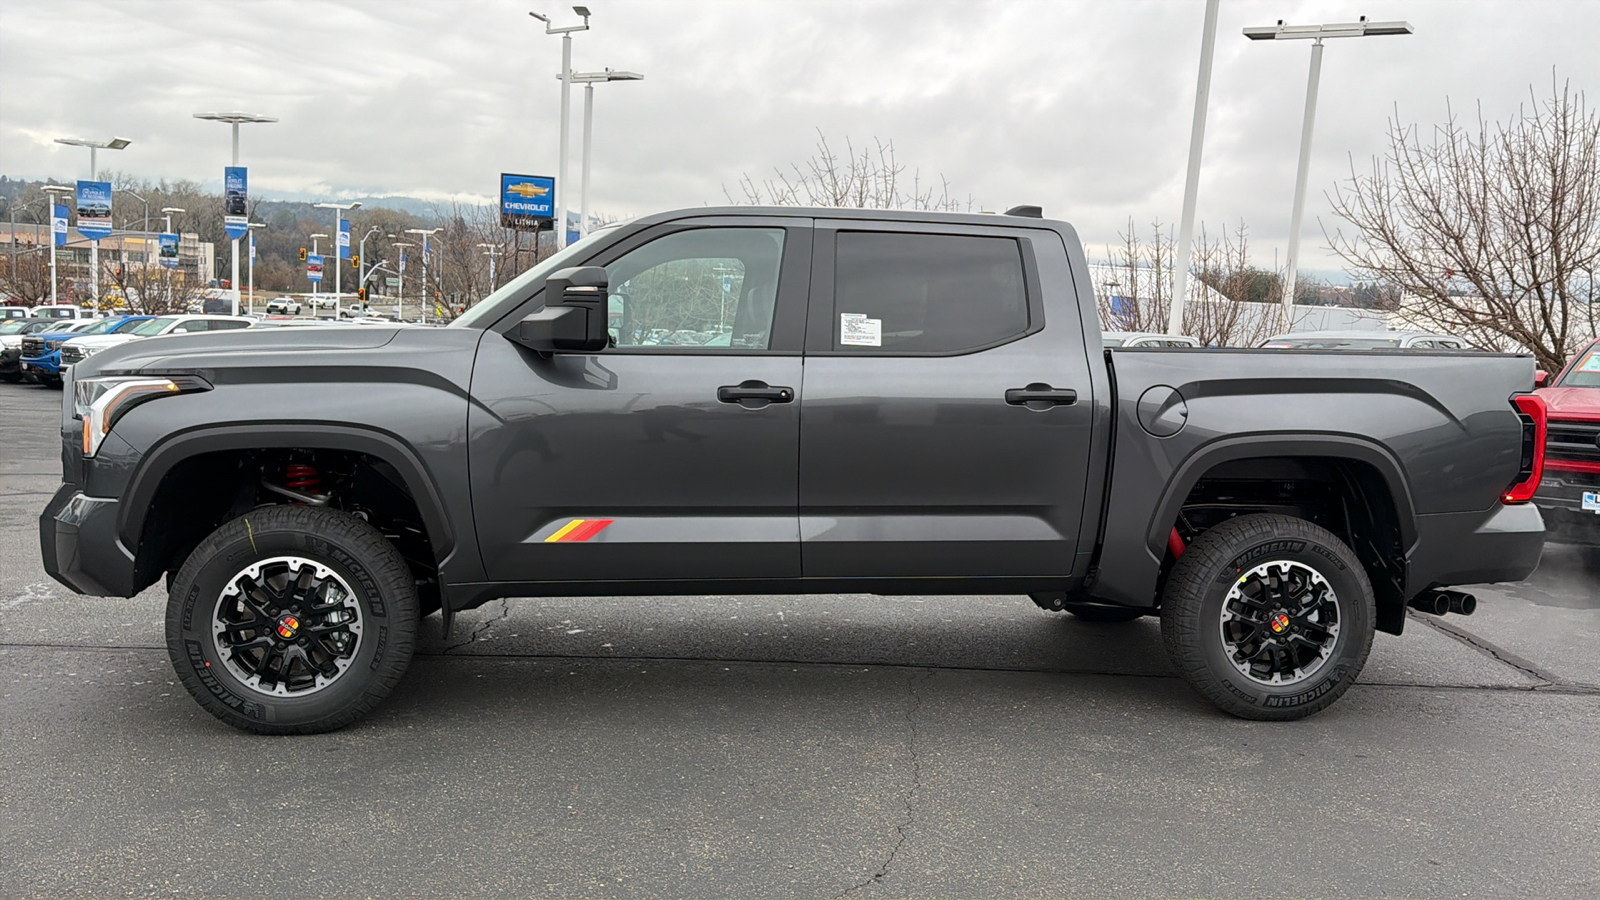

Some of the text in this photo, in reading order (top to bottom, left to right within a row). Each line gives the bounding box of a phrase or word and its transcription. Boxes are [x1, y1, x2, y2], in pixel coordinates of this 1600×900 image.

[504, 201, 550, 212] CHEVROLET
[514, 218, 539, 226] LITHIA
[1236, 541, 1306, 566] MICHELIN
[329, 547, 383, 616] MICHELIN
[187, 641, 243, 710] MICHELIN
[1266, 678, 1335, 706] MICHELIN
